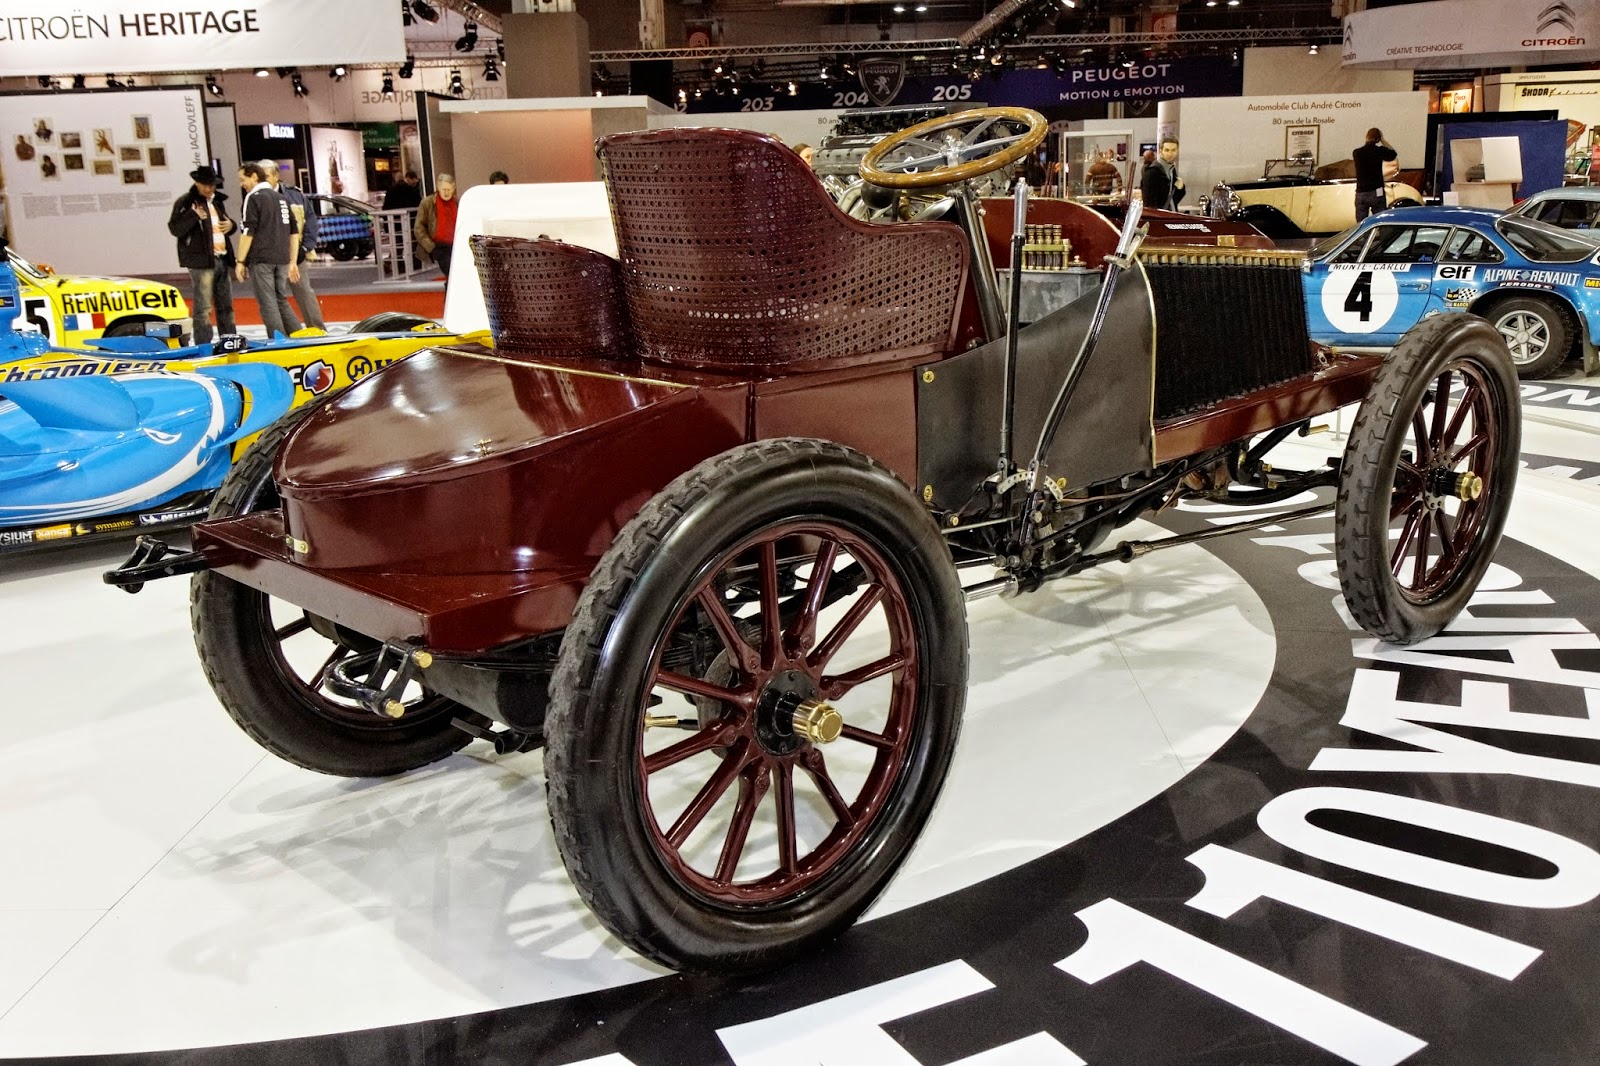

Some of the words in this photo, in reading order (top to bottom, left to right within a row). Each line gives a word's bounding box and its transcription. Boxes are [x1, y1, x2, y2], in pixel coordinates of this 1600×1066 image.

[0, 9, 110, 41] ITROËN
[119, 9, 260, 37] HERITAGE
[1387, 47, 1413, 56] CRÉATIVE
[1414, 43, 1464, 53] TECHNOLOGIE
[1072, 64, 1171, 83] PEUGEOT
[832, 91, 870, 106] 204
[932, 84, 972, 101] 205
[1059, 90, 1110, 101] MOTION
[1113, 90, 1121, 98] &
[1124, 85, 1185, 97] EMOTION
[741, 97, 775, 111] 203
[1247, 103, 1290, 111] Automobile
[1291, 102, 1309, 110] Club
[1311, 101, 1333, 110] André
[1334, 100, 1361, 109] Citroën
[1272, 117, 1282, 125] 80
[1312, 116, 1335, 124] Rosalie
[1333, 263, 1407, 271] MONTE-CARLO
[1440, 265, 1472, 279] elf
[1484, 269, 1522, 282] ALPINE
[1529, 271, 1580, 287] RENAULT
[61, 290, 141, 314] RENAULT
[141, 289, 178, 308] elf
[1344, 271, 1373, 322] 4
[224, 339, 242, 350] elf
[95, 520, 135, 531] symantec
